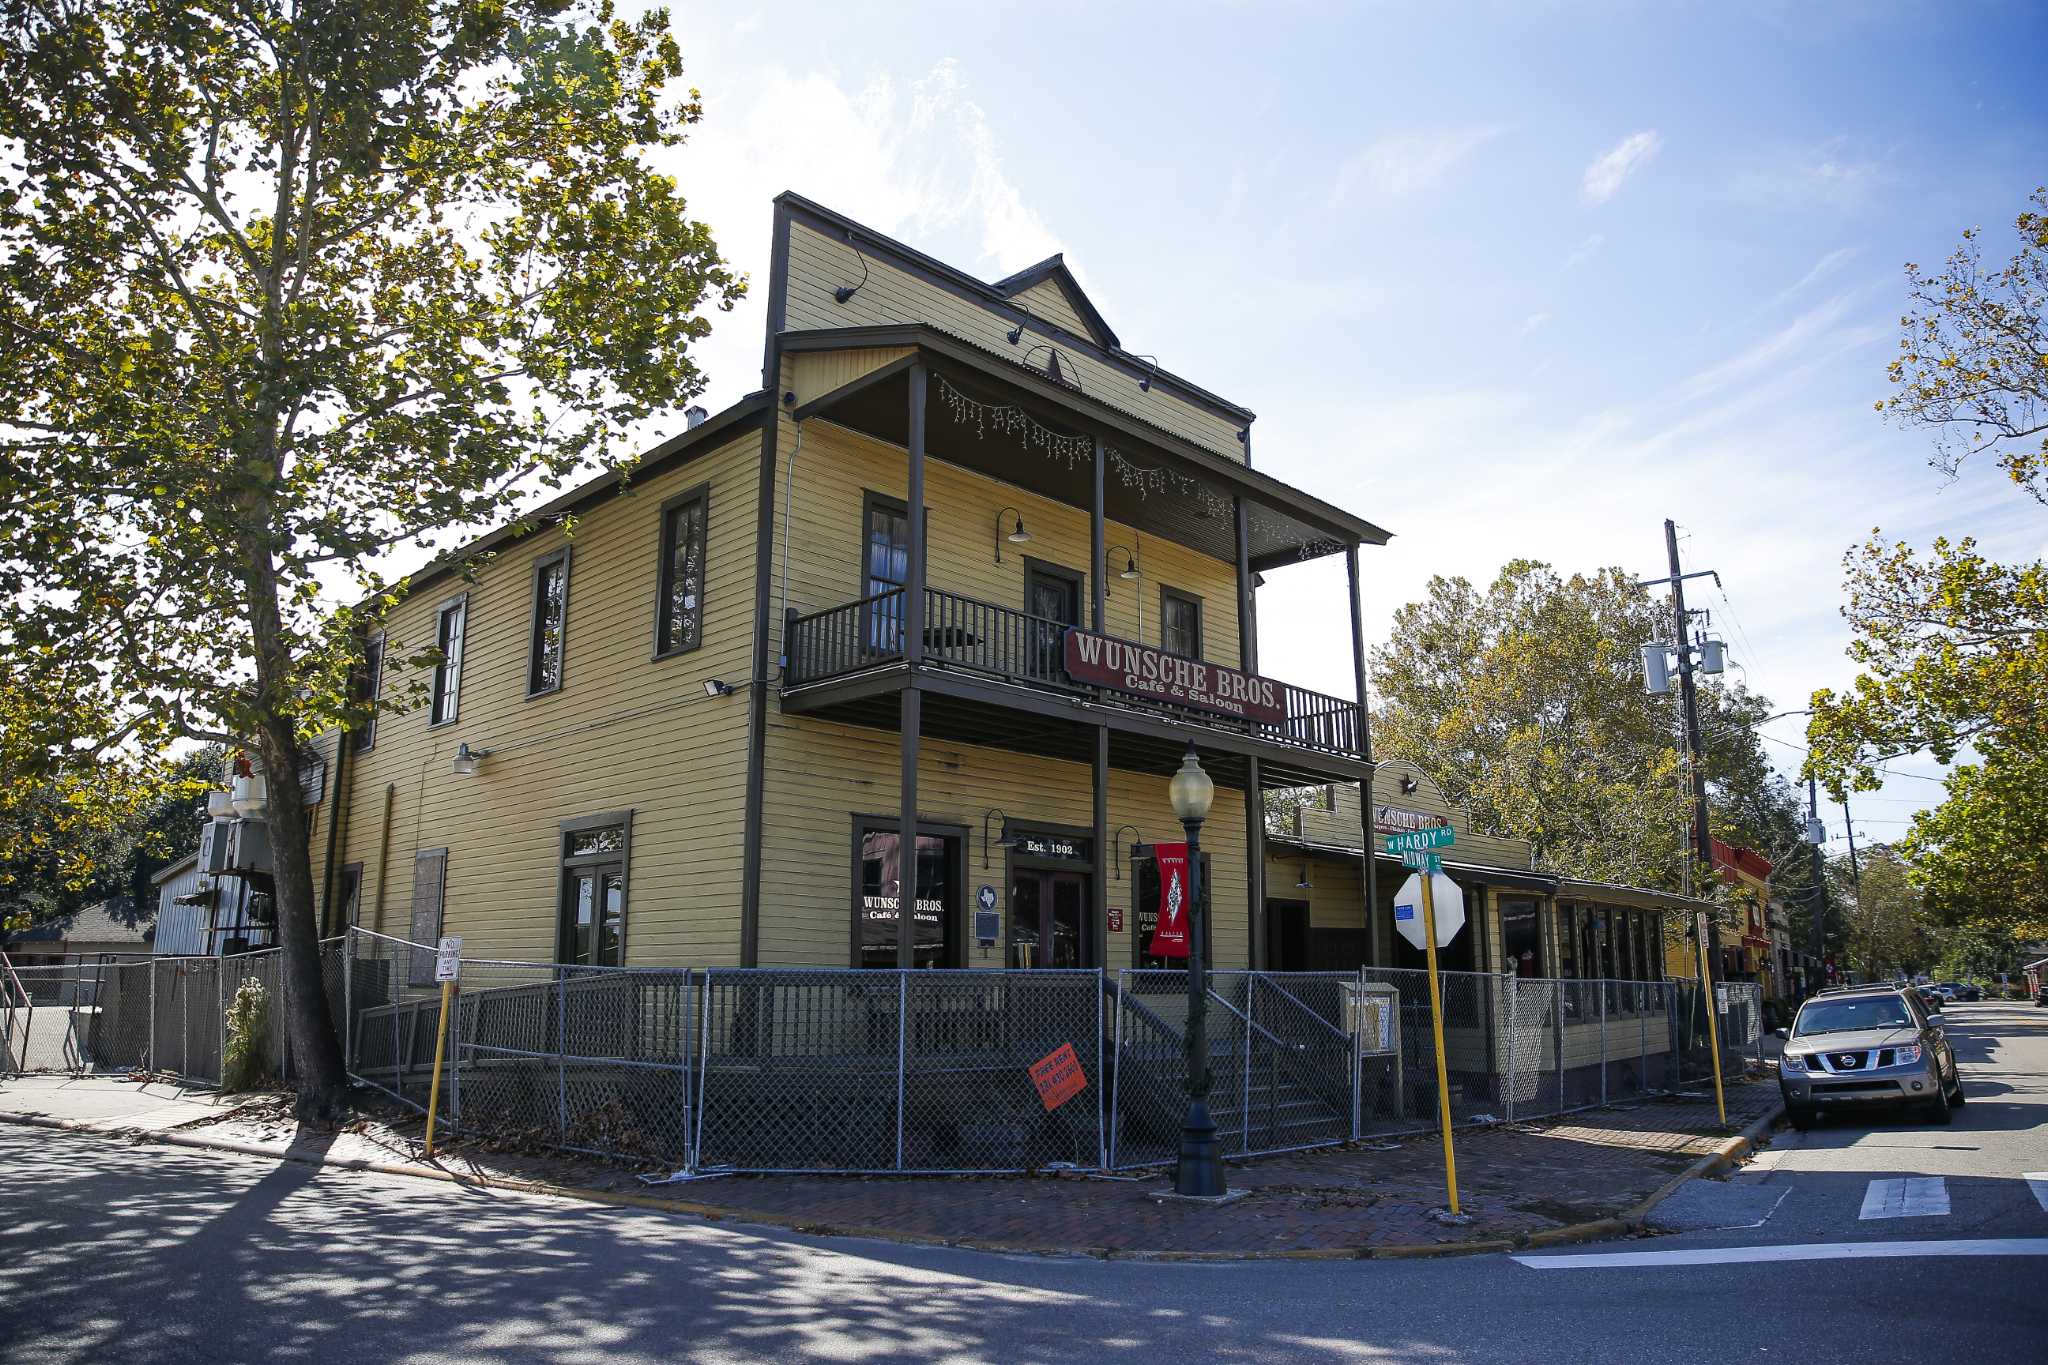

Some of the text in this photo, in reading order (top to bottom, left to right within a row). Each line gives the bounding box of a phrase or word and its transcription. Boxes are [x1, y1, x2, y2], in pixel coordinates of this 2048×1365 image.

[1076, 632, 1281, 710] WUNSCHE BROS.
[1125, 674, 1244, 714] Café & Saloon
[1027, 840, 1073, 855] Est. 1902
[1387, 841, 1394, 849] W
[1397, 831, 1437, 851] HARDY
[1441, 828, 1452, 837] RD
[1403, 850, 1429, 868] MIDWAY
[863, 896, 944, 912] WUNSC BROS.
[869, 910, 892, 919] Café
[913, 912, 938, 921] aloon
[445, 940, 455, 949] NO
